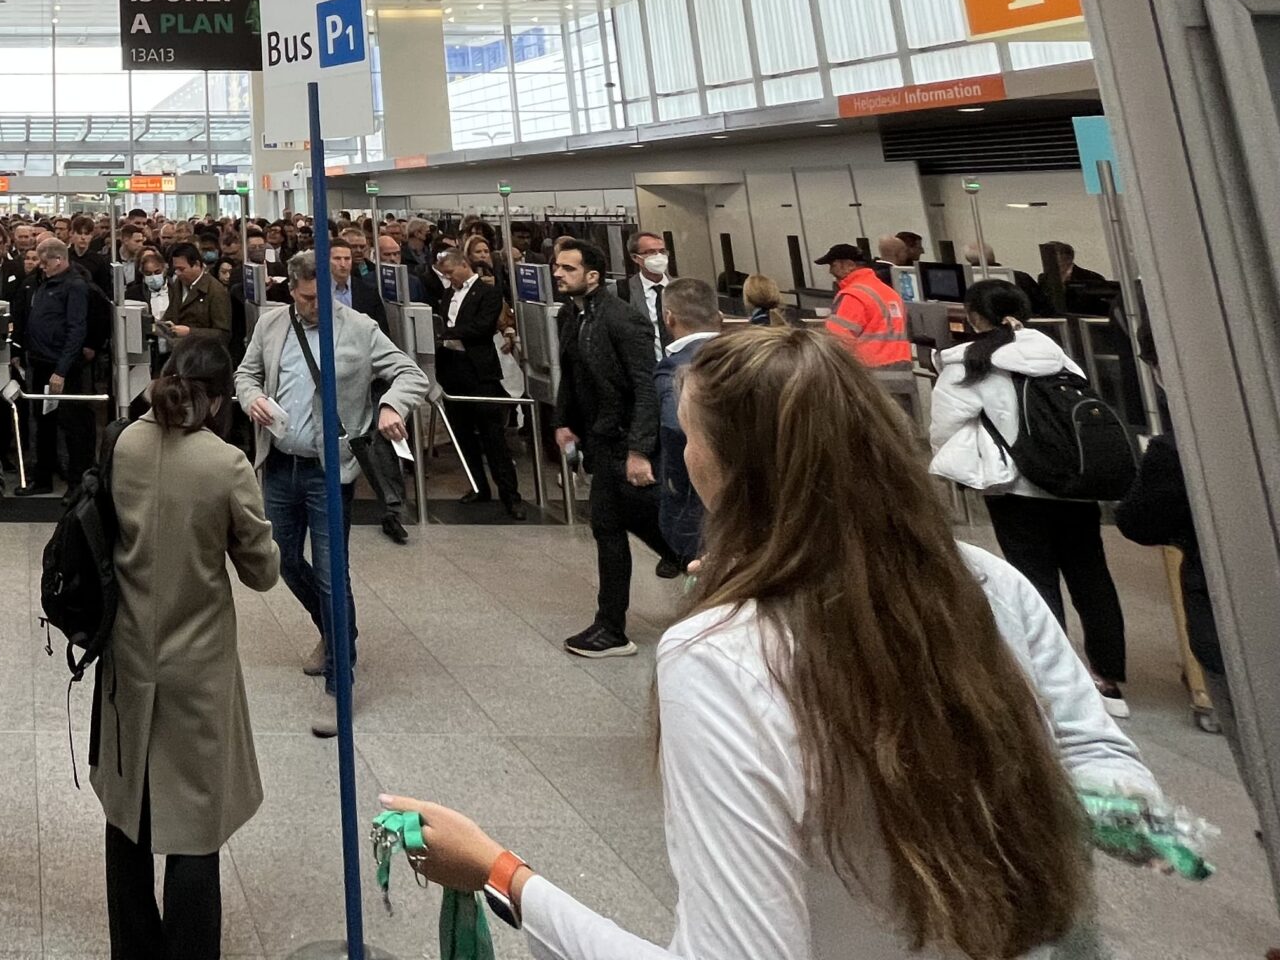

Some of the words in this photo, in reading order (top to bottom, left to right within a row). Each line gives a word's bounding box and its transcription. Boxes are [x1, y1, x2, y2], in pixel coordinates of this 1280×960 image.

[130, 13, 152, 34] A
[160, 13, 234, 34] PLAN
[325, 14, 354, 55] P1
[130, 48, 175, 62] 13A13
[267, 31, 313, 67] Bus
[904, 83, 982, 105] Information
